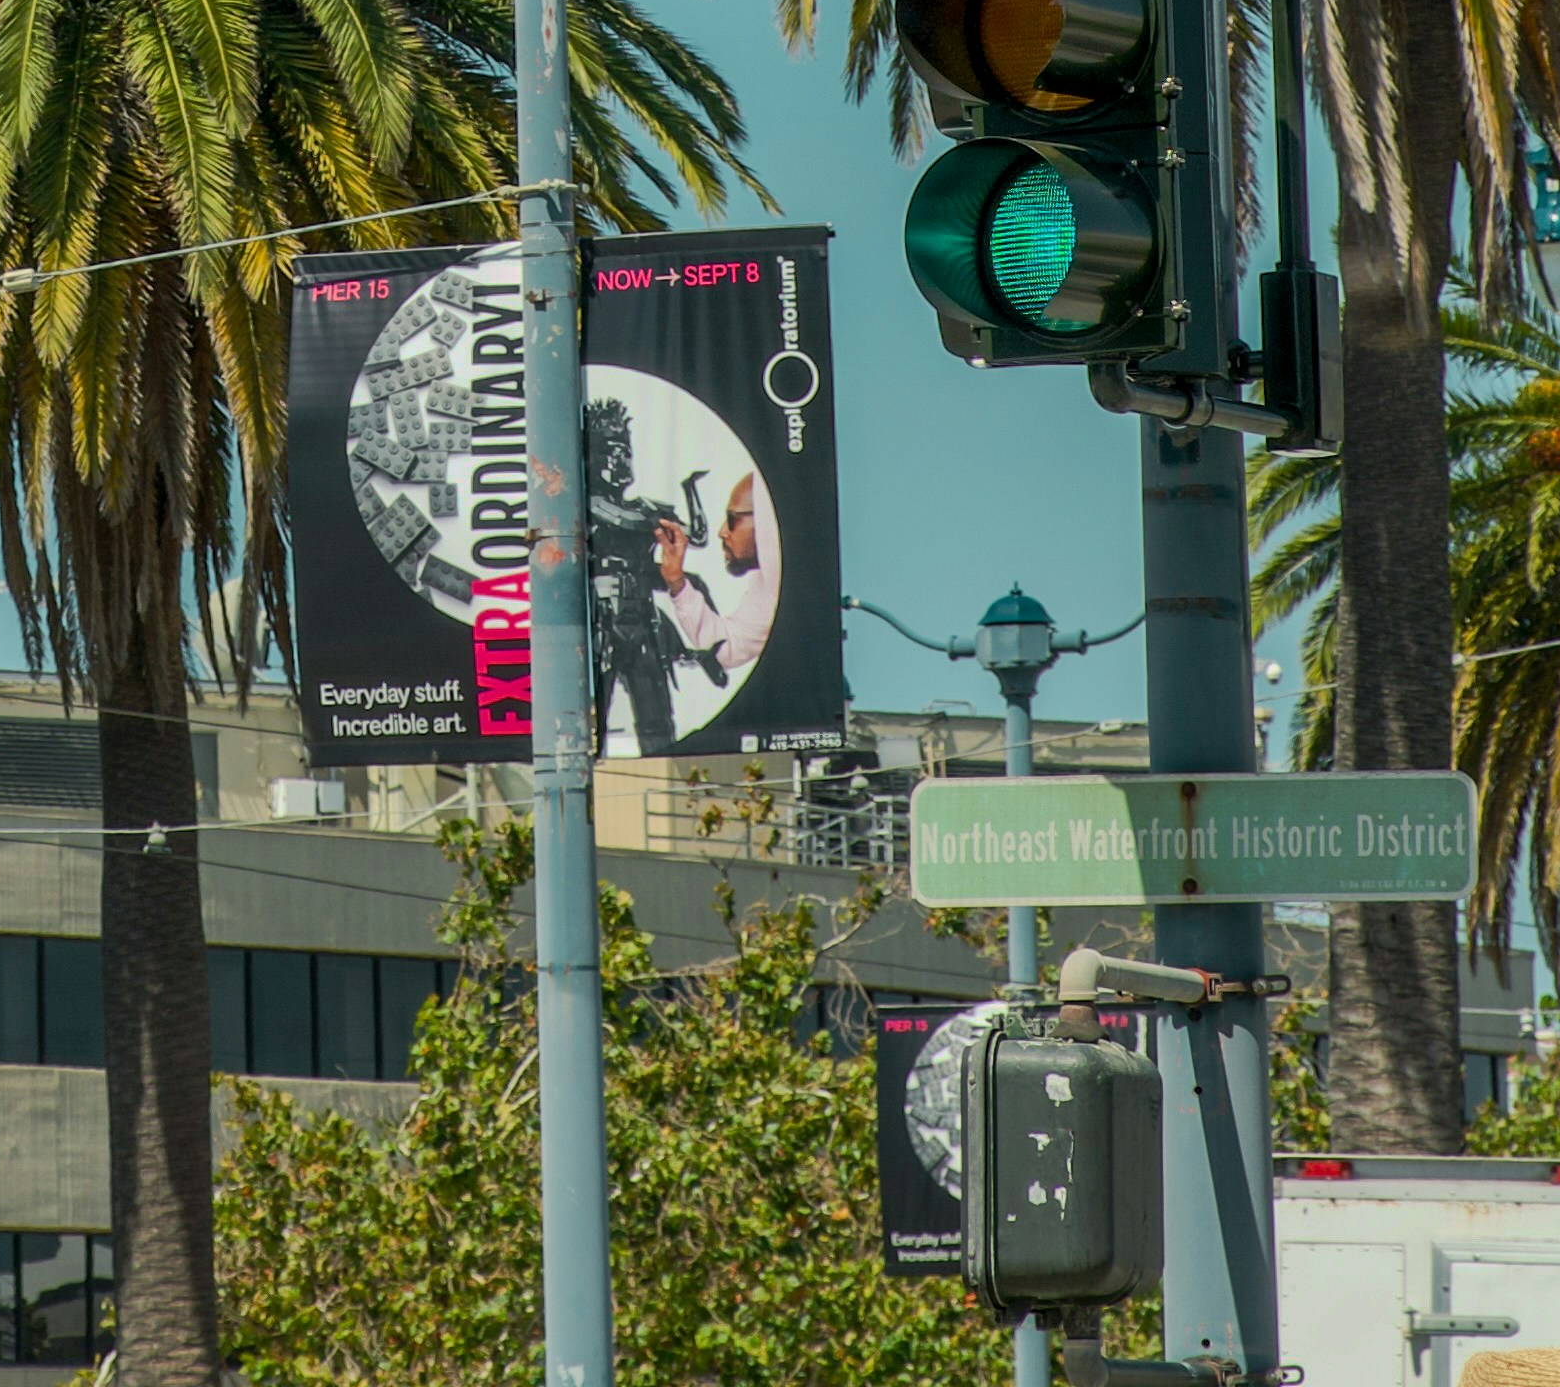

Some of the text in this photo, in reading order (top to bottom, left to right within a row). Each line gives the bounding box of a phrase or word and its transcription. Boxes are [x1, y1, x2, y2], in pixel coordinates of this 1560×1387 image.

[312, 279, 389, 302] PIER 15
[597, 262, 760, 291] NOW SEPT 8
[319, 680, 464, 710] Everyday stuff.
[332, 712, 467, 737] Incredible art.
[921, 812, 1466, 865] Northeast Waterfront Historic District
